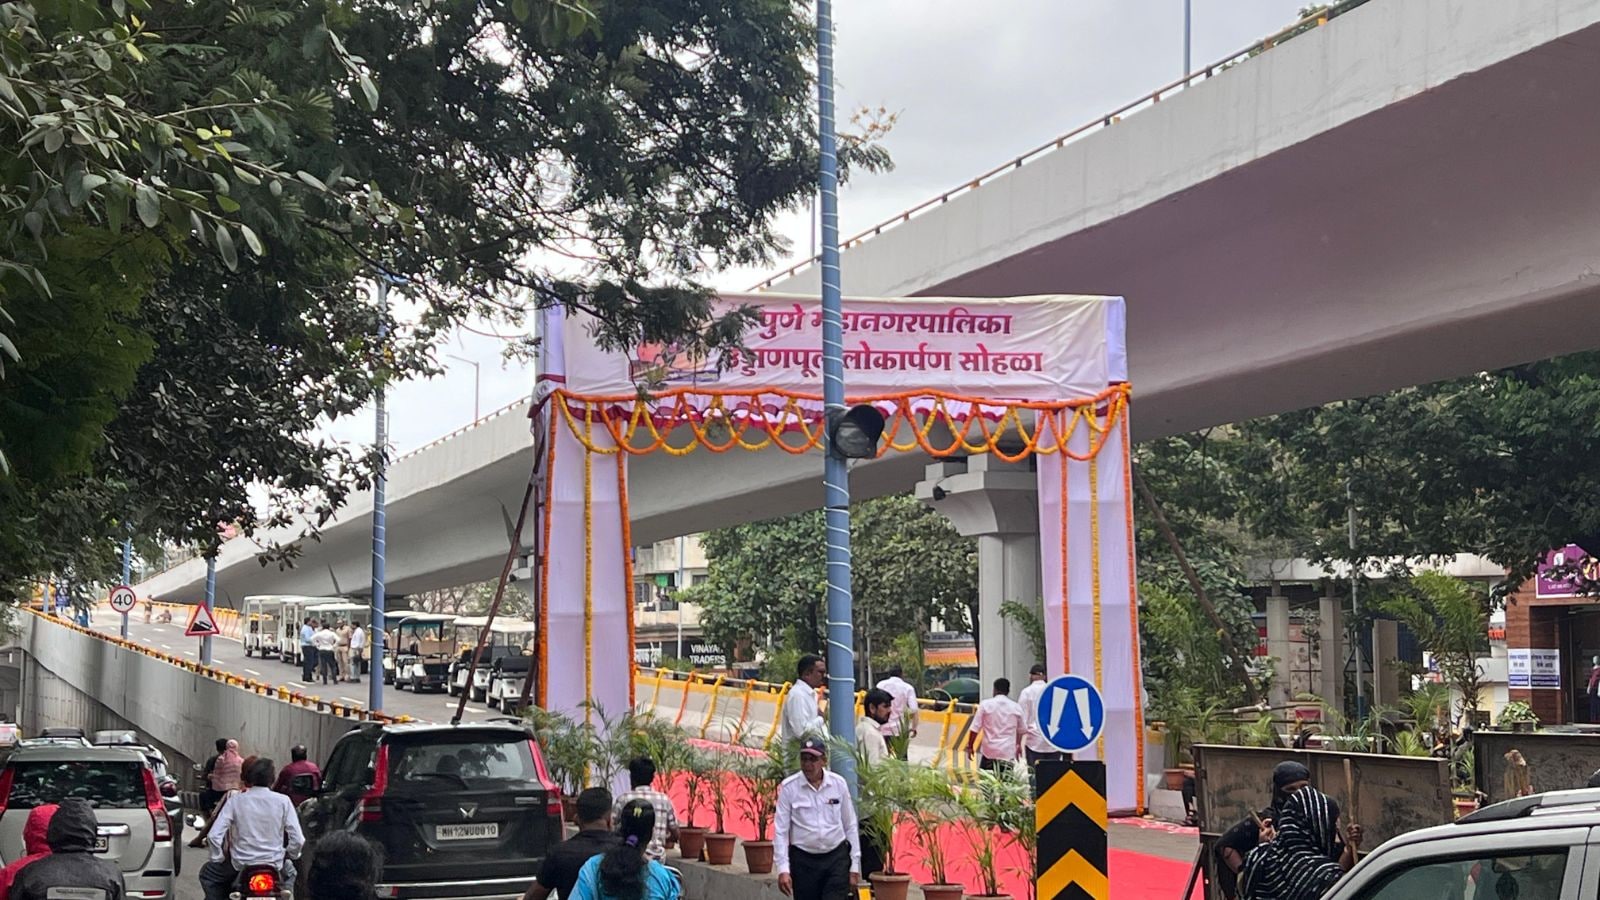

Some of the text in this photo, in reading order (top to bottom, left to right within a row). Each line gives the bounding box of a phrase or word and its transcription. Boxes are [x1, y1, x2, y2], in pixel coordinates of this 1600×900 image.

[760, 303, 805, 340] पुणे
[842, 341, 952, 371] लोकार्पण
[958, 343, 1043, 375] सोहळा
[113, 594, 132, 606] 40
[690, 643, 724, 654] VINAYA
[689, 655, 726, 665] TRADERS
